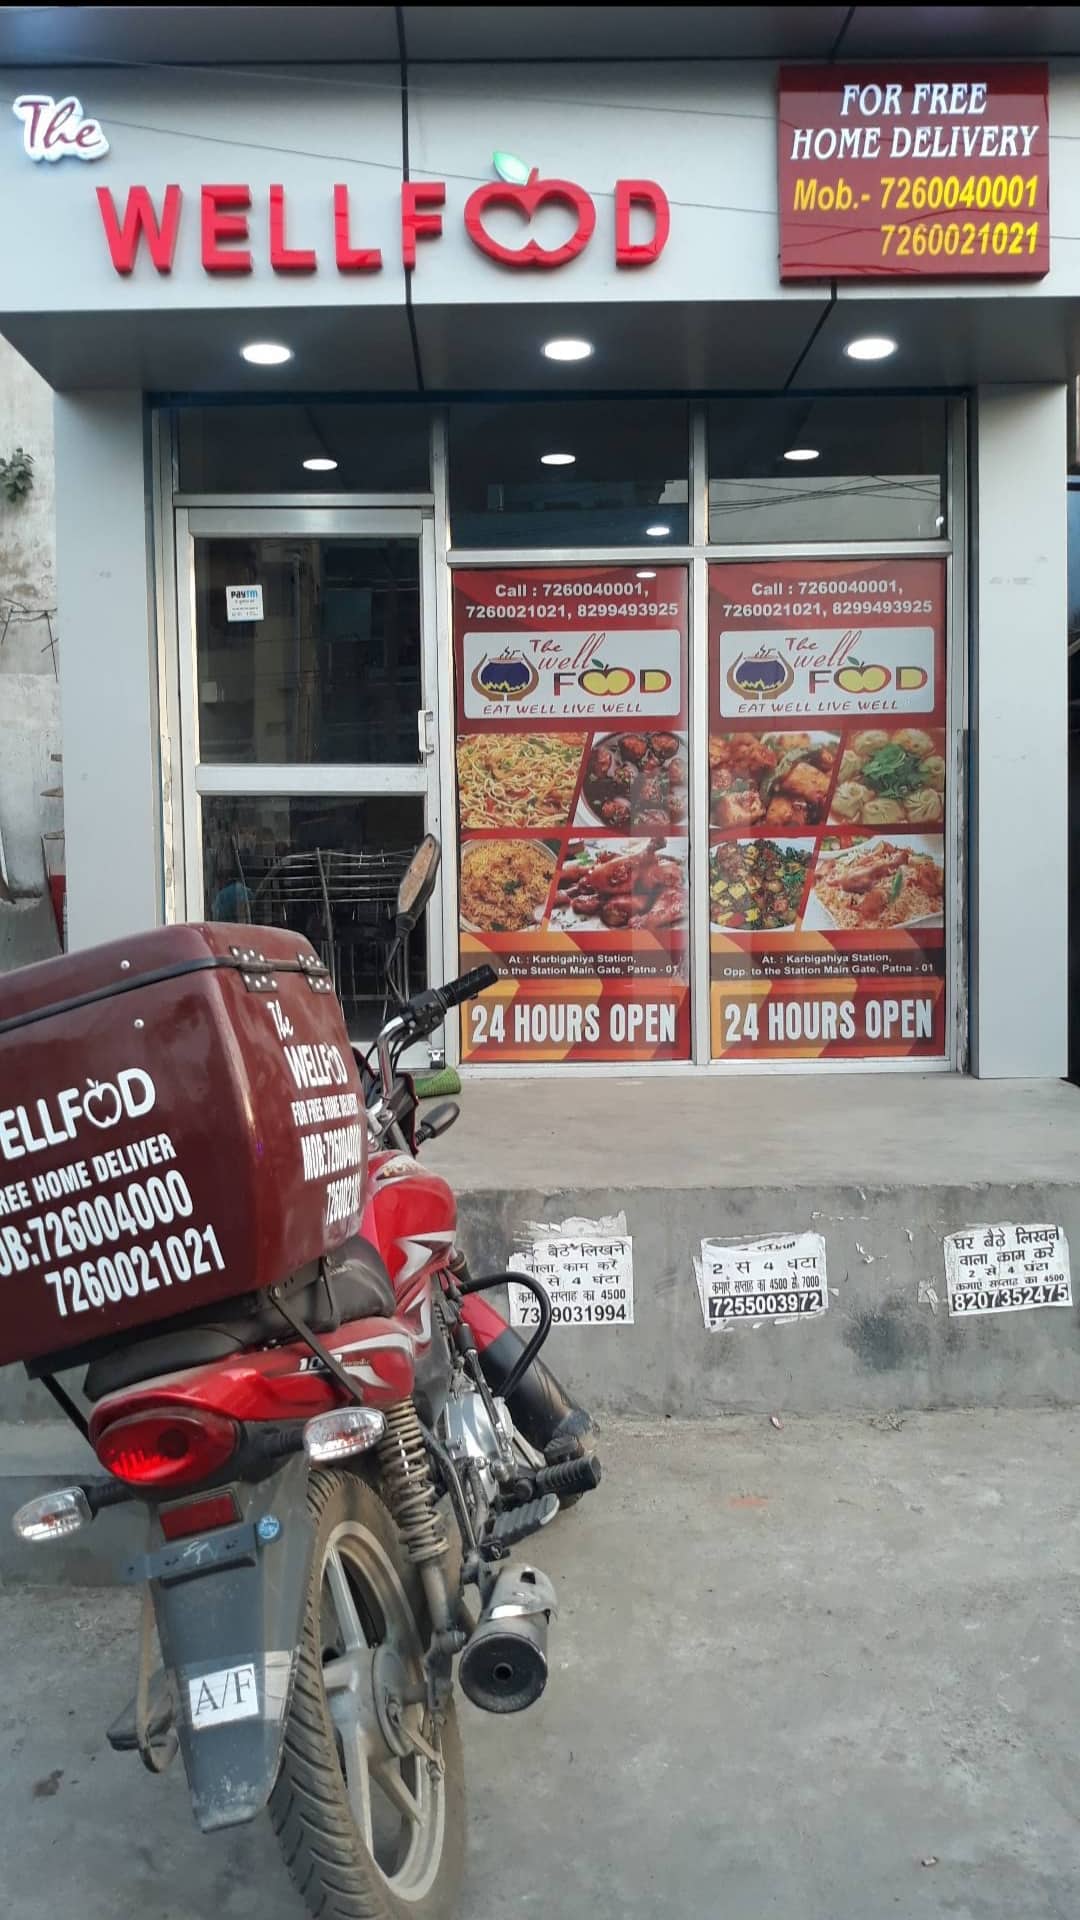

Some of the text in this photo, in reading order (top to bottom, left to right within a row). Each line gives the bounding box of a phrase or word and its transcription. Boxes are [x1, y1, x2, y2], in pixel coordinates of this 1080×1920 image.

[840, 82, 987, 116] FOR FREE
[17, 98, 105, 153] The
[790, 125, 1039, 160] HOME DELIVERY
[880, 174, 1038, 209] 7260040001
[880, 222, 1039, 256] 7260021021
[495, 584, 527, 597] Call
[543, 582, 649, 597] 7260040001,
[751, 583, 783, 596] Call
[798, 580, 903, 595] 7260040001,
[466, 603, 678, 620] 7260021021, 8299493925
[722, 601, 933, 618] 7260021021, 8299493925
[529, 639, 563, 653] The
[538, 633, 606, 670] well
[785, 637, 819, 650] The
[794, 630, 862, 668] well
[553, 665, 672, 696] FOOD
[808, 663, 928, 694] FOOD
[483, 702, 643, 715] EAT WELL LIVE WELL
[738, 700, 898, 713] EAT WELL LIVE WELL
[532, 955, 594, 965] Karbigahiya
[597, 954, 637, 965] Station,
[786, 954, 849, 965] Karbigahiya
[852, 953, 892, 964] Station,
[498, 967, 509, 975] to
[511, 966, 528, 975] the
[530, 966, 567, 975] Station
[569, 966, 594, 974] Main
[627, 965, 657, 974] Patna
[751, 966, 761, 975] to
[764, 966, 781, 975] the
[784, 965, 822, 975] Station
[824, 965, 849, 974] Main
[882, 964, 912, 973] Patna
[921, 964, 933, 972] 01
[471, 1003, 676, 1043] 24 HOURS OPEN
[725, 999, 932, 1042] 24 HOURS OPEN
[31, 1160, 92, 1203] HOME
[92, 1133, 177, 1184] DELIVER
[953, 1237, 975, 1250] घर
[984, 1228, 1005, 1247] बैठे
[581, 1241, 625, 1256] लिखने
[959, 1253, 988, 1266] वाला
[996, 1249, 1025, 1263] काम
[44, 1224, 225, 1317] 7260021021
[563, 1262, 588, 1272] काम
[712, 1264, 723, 1274] 2
[968, 1270, 976, 1278] 2
[770, 1277, 788, 1290] 4500
[802, 1275, 820, 1288] 7000
[1044, 1273, 1064, 1283] 4500
[601, 1289, 626, 1300] 4500
[955, 1284, 1068, 1311] 8207352475
[712, 1291, 820, 1317] 7255003972
[520, 1304, 626, 1324] 739031994
[196, 1669, 253, 1716] A/F
